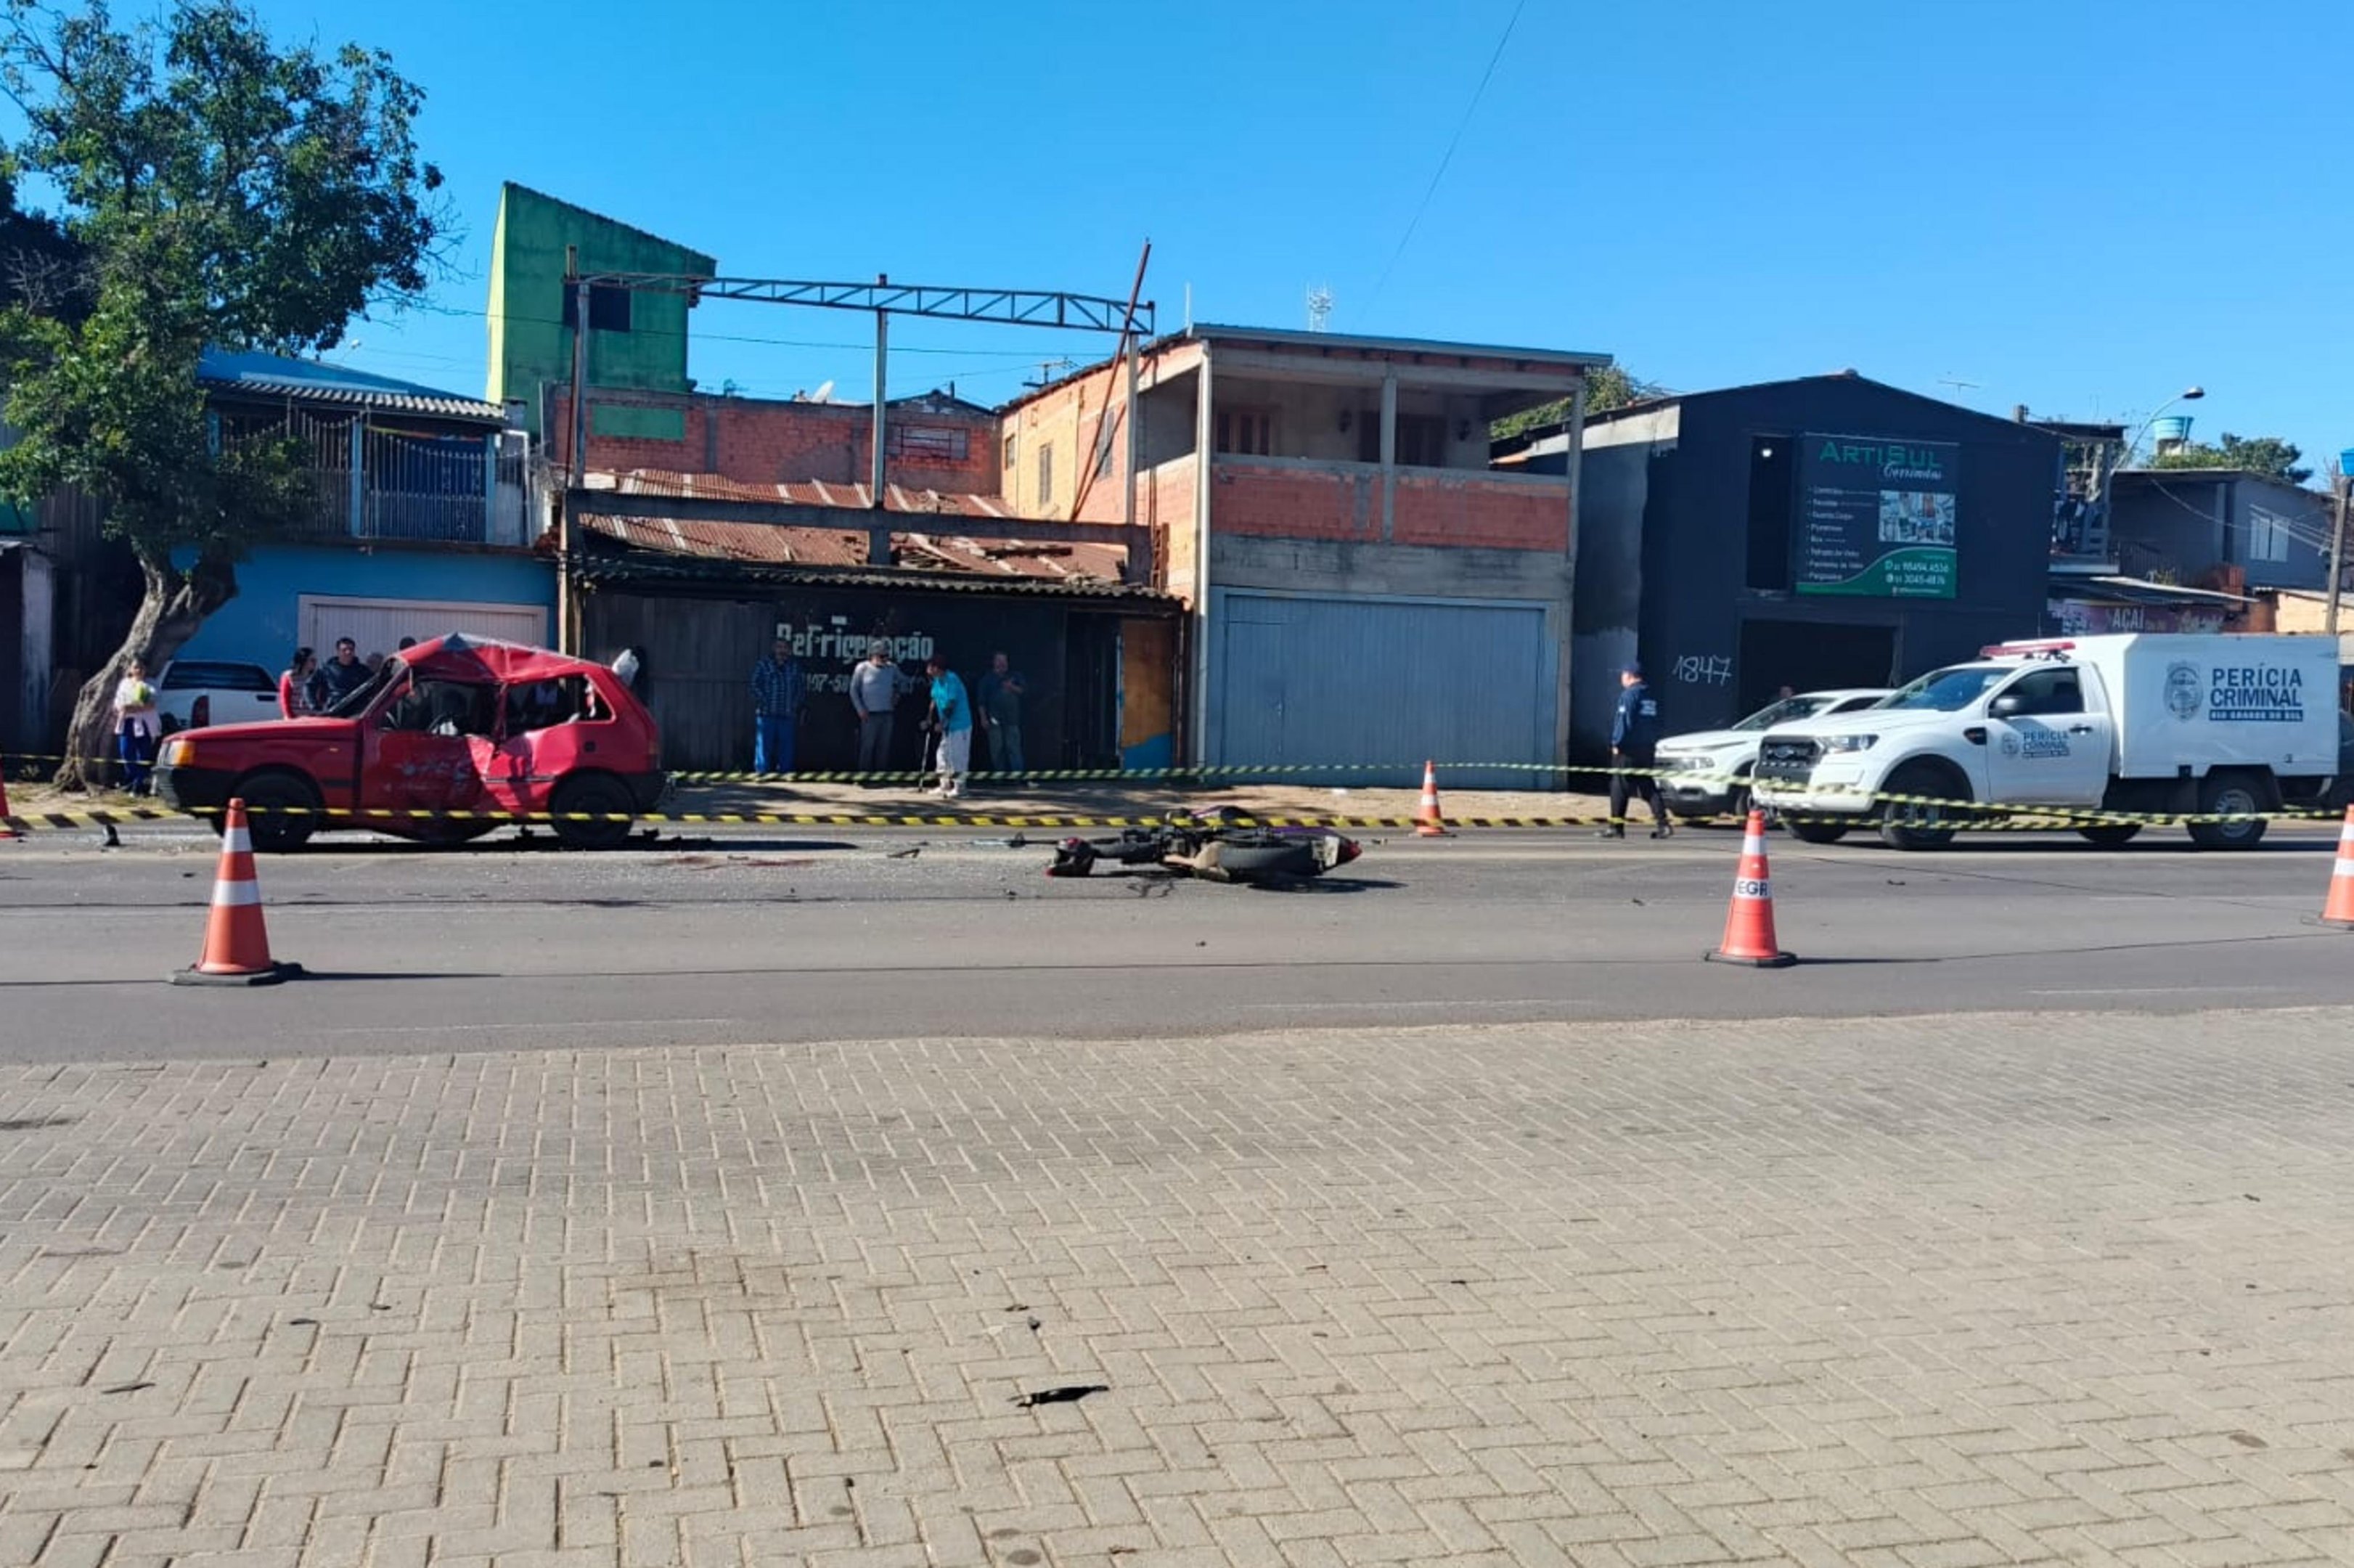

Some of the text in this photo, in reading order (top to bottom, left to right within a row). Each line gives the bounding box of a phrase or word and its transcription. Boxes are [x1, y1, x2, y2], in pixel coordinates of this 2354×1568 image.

[1672, 655, 1733, 687] 1847
[2212, 663, 2302, 687] PERÍCIA
[2210, 688, 2302, 707] CRIMINAL
[1738, 881, 1768, 897] EGR
